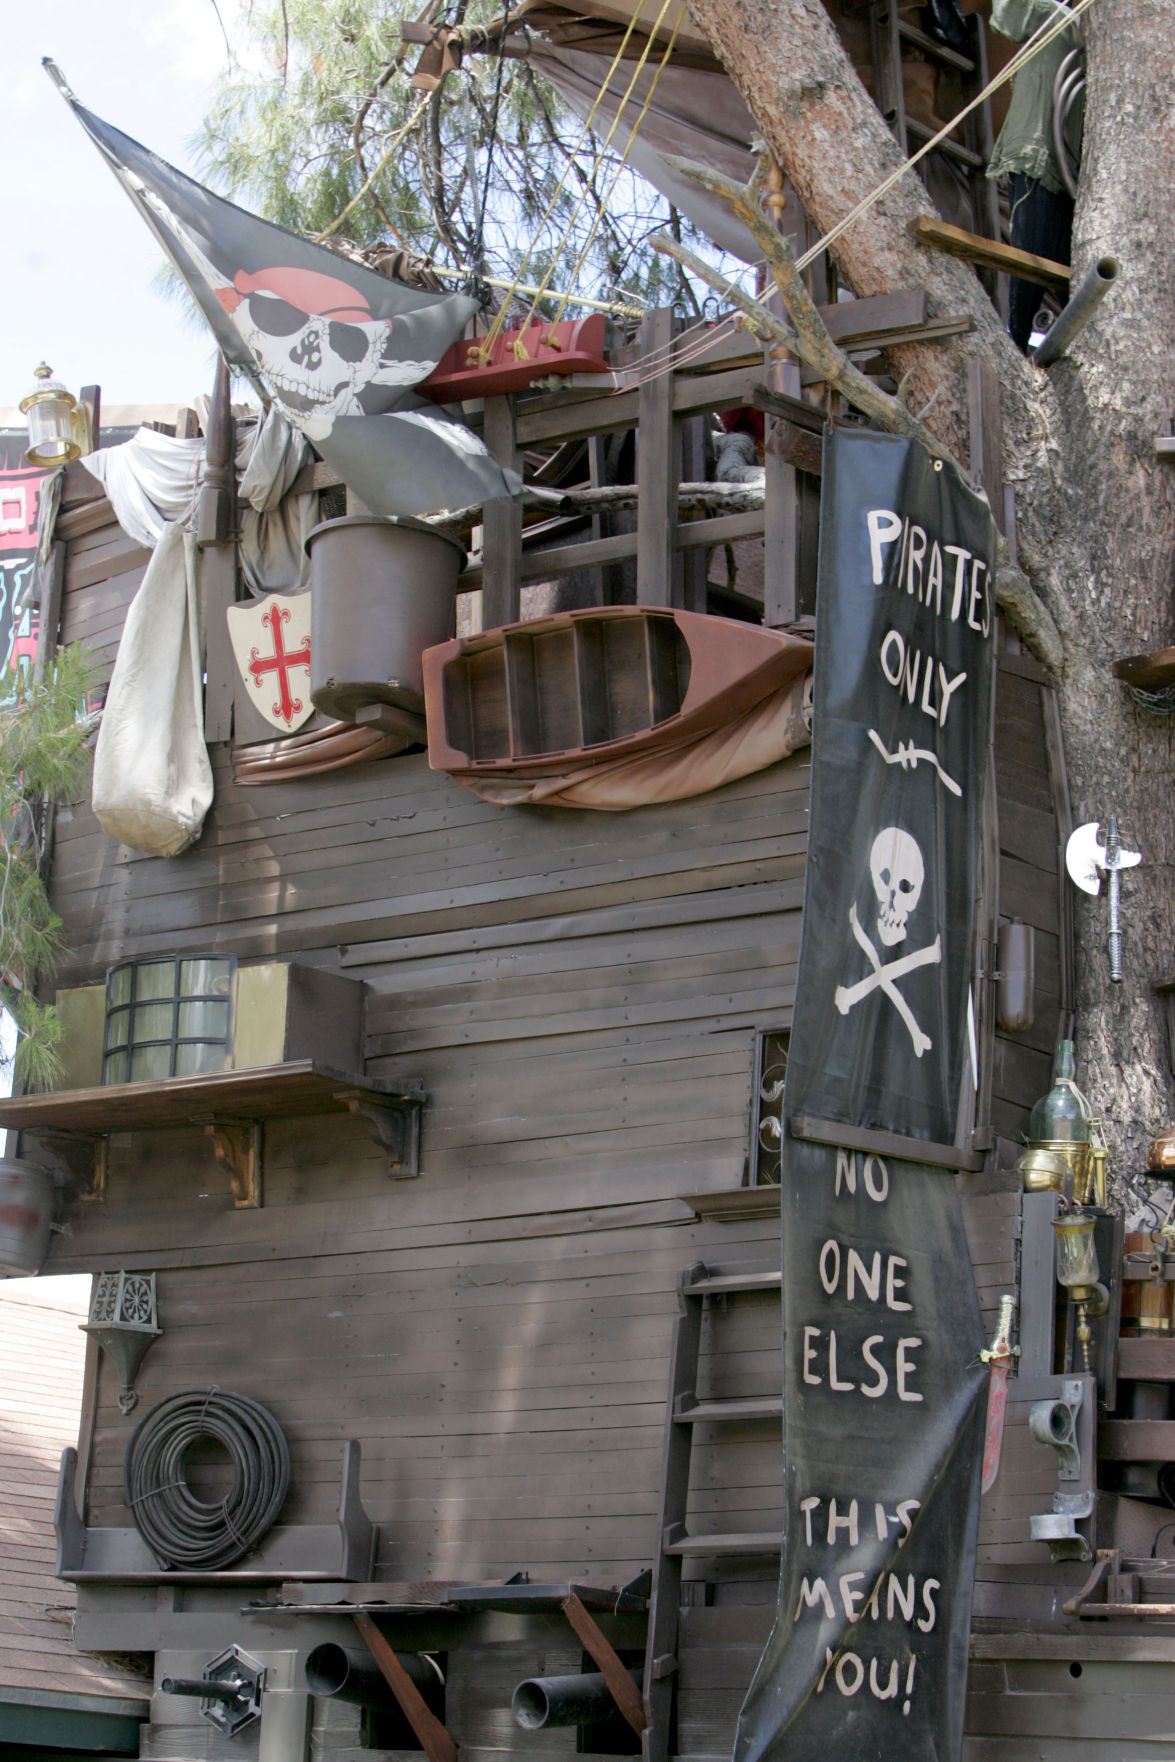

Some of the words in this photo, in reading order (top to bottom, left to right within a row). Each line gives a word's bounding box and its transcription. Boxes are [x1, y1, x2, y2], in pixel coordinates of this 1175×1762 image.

[866, 508, 993, 640] PIRATES
[880, 629, 968, 729] ONLY
[834, 1150, 889, 1203] NO
[818, 1238, 913, 1312] ONE
[803, 1324, 925, 1402] ELSE
[800, 1496, 921, 1549] THIS
[816, 1645, 917, 1717] YOU!
